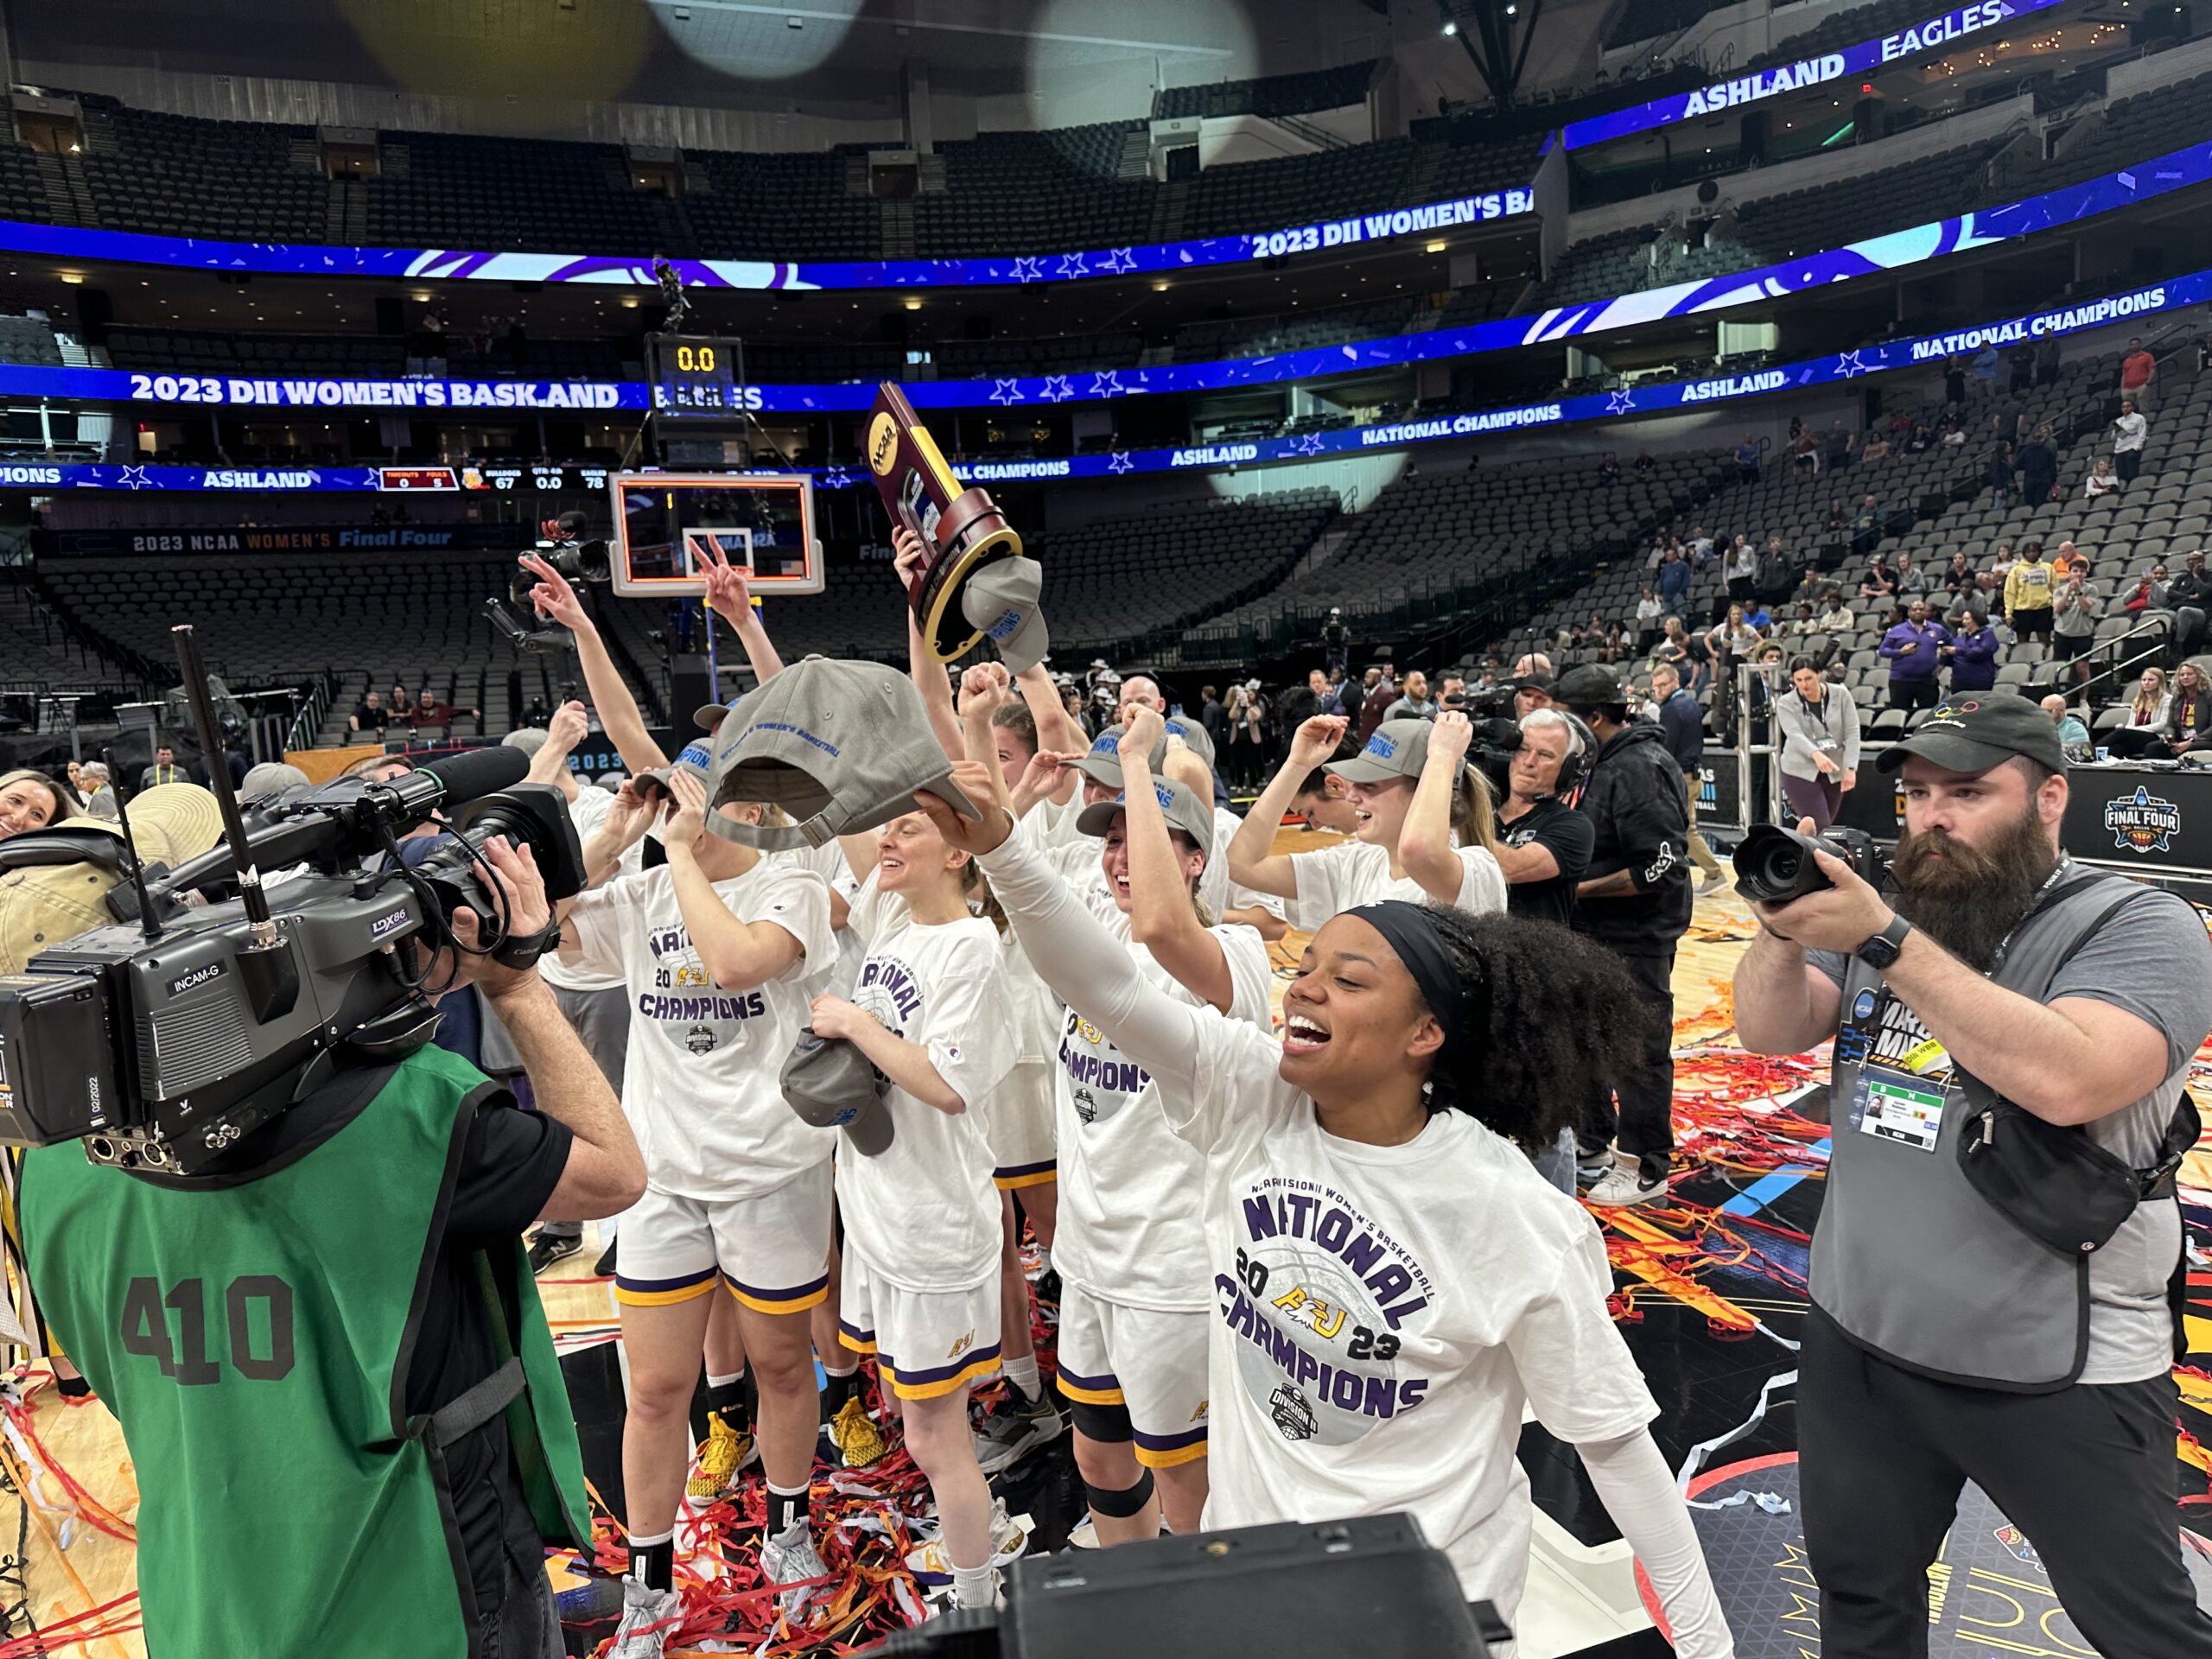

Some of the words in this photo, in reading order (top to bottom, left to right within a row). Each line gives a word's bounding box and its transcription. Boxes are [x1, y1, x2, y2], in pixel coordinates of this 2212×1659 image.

[1684, 54, 1846, 118] ASHLAND
[1882, 2, 2002, 63] EAGLES
[1252, 227, 1319, 258] 2023
[1323, 220, 1362, 249] DII
[1367, 195, 1502, 239] WOMEN'S
[677, 346, 715, 372] 0.0
[1681, 371, 1785, 403] ASHLAND
[1913, 322, 2028, 359] NATIONAL
[2031, 288, 2166, 336] CHAMPIONS
[130, 375, 224, 404] 2023
[228, 380, 280, 404] DII
[283, 380, 446, 406] WOMEN'S
[873, 423, 895, 472] NCAA
[1171, 444, 1258, 466] ASHLAND
[1362, 420, 1452, 445] NATIONAL
[1453, 404, 1560, 434] CHAMPIONS
[202, 471, 313, 488] ASHLAND
[399, 478, 410, 488] 0
[494, 477, 515, 490] 67
[536, 476, 563, 490] 0.0
[584, 476, 605, 489] 78
[973, 461, 1071, 480] CHAMPIONS
[133, 536, 184, 552] 2023
[190, 535, 240, 551] NCAA
[245, 533, 332, 550] WOMEN'S
[339, 529, 397, 547] Final
[400, 531, 453, 546] Four
[859, 543, 896, 561] Fin
[569, 752, 622, 771] 2023
[2107, 810, 2141, 825] FINAL
[2143, 811, 2177, 830] FOUR
[372, 908, 406, 933] LDX86
[174, 964, 219, 993] INCAM-G
[655, 968, 671, 988] 20
[639, 991, 766, 1021] CHAMPIONS
[89, 1076, 101, 1113] 02/2022
[1325, 1187, 1376, 1232] WOMEN'S
[1376, 1229, 1436, 1300] BASKETBALL
[1236, 1246, 1269, 1300] 20
[120, 1274, 296, 1387] 410
[1346, 1325, 1402, 1362] 23
[1214, 1272, 1429, 1420] CHAMPIONS
[1271, 1389, 1309, 1426] DIVISION
[1310, 1419, 1317, 1432] II
